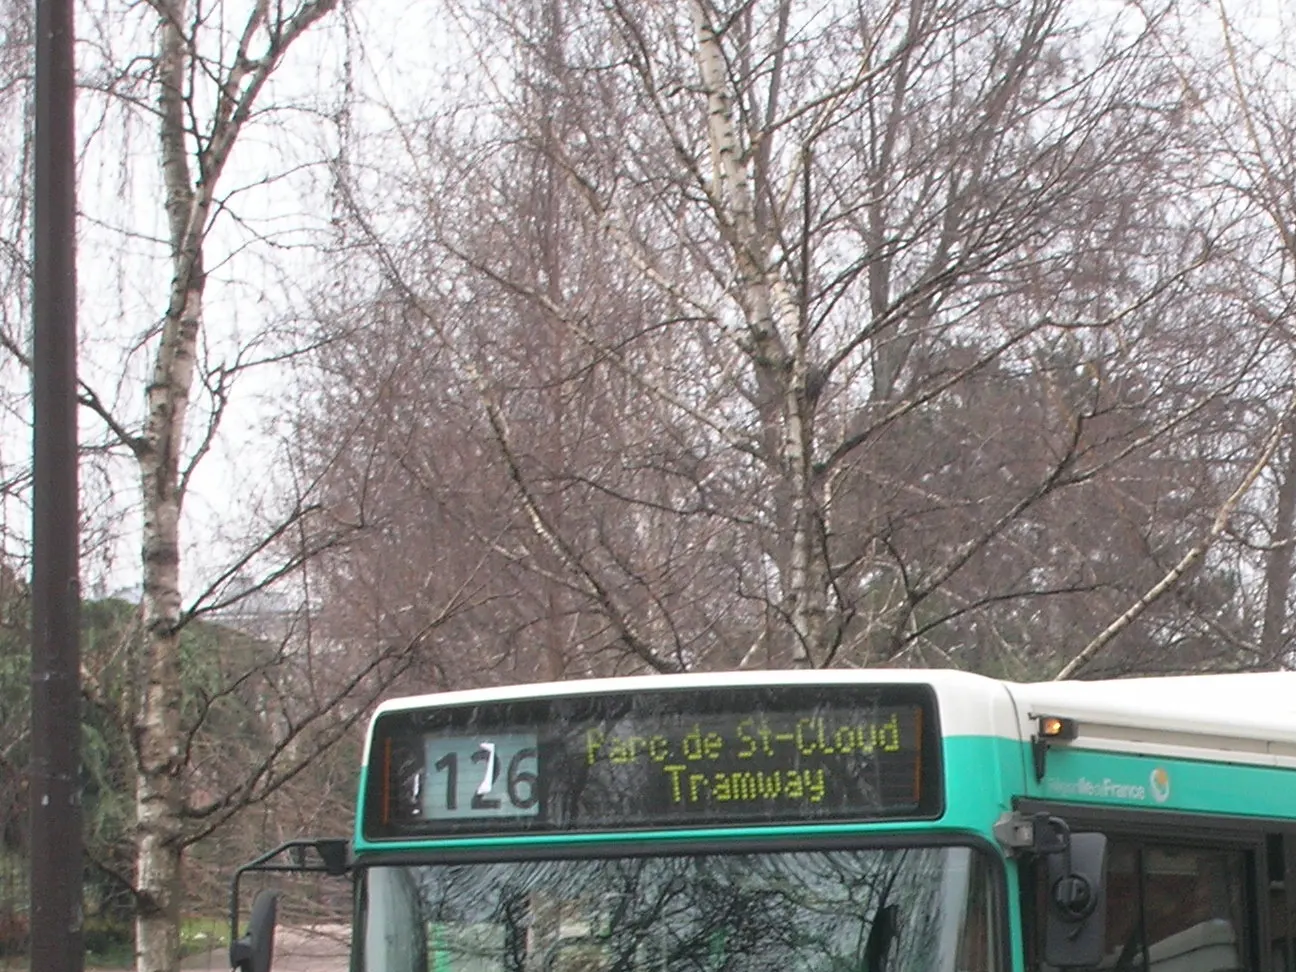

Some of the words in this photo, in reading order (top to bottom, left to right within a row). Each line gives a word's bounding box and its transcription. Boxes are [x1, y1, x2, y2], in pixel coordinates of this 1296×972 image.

[586, 726, 669, 766] Parc
[683, 722, 723, 761] de
[736, 713, 899, 758] St-Cloud
[434, 748, 538, 810] 126
[664, 763, 826, 802] Tramway
